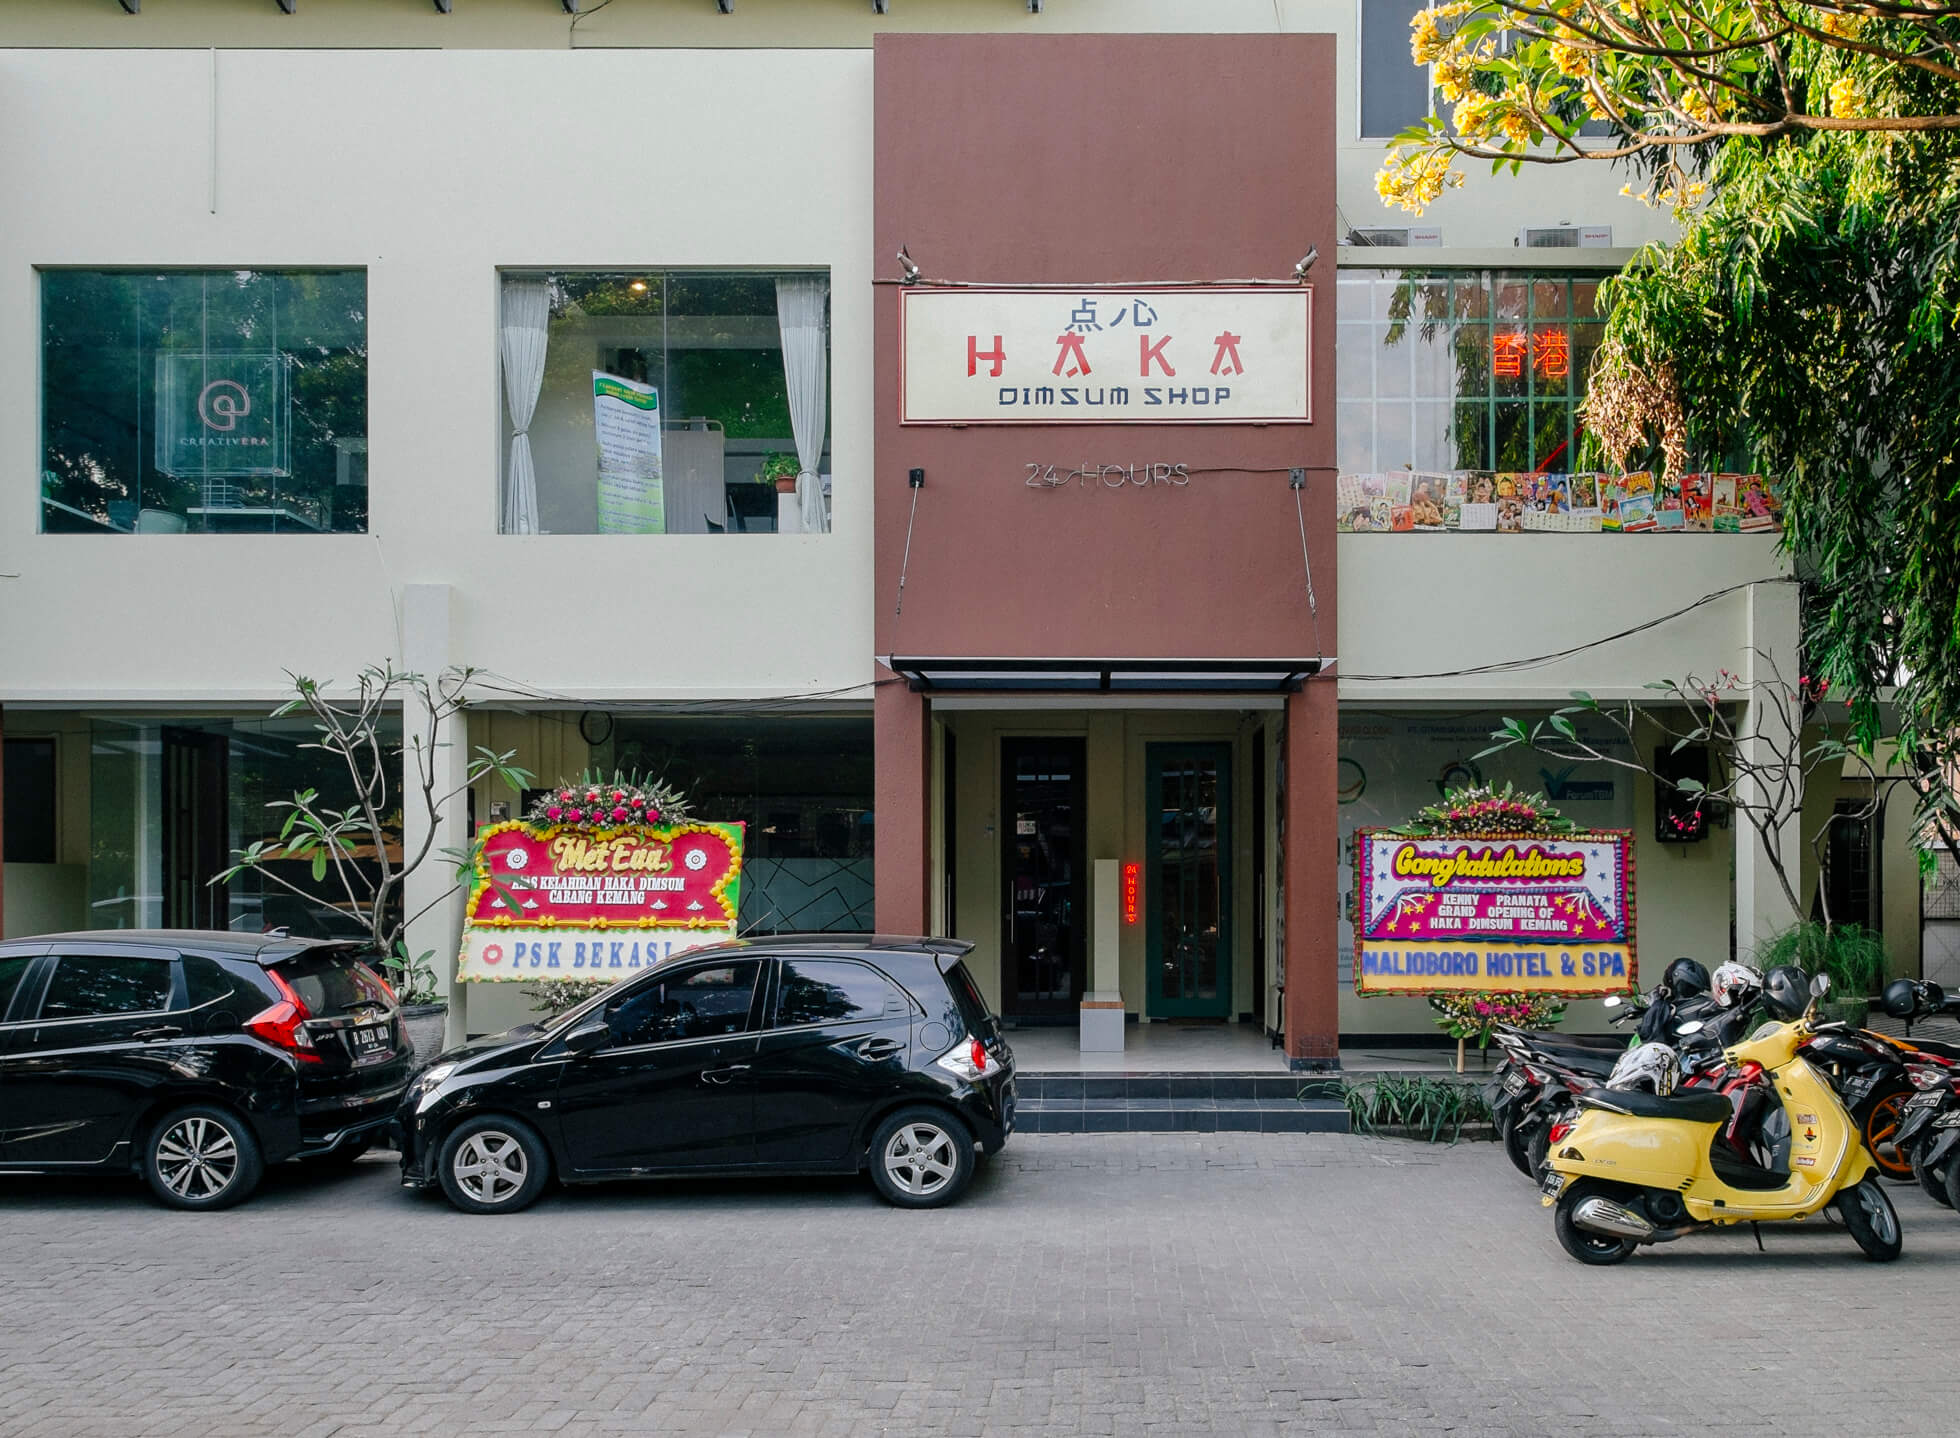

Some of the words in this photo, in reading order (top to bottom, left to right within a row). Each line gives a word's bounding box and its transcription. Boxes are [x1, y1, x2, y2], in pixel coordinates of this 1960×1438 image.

[967, 331, 1245, 378] HAKA
[1493, 329, 1569, 377] 香港
[998, 386, 1129, 406] DIMSUM
[1143, 387, 1231, 406] SHOP
[180, 437, 269, 447] CREATIVERA
[1025, 463, 1060, 487] 24
[1081, 463, 1189, 487] HOURS
[553, 836, 610, 871] Met
[1126, 865, 1137, 874] 24
[1394, 846, 1584, 887] Congratulations
[540, 876, 600, 890] KELAHIRAN
[604, 877, 635, 890] HAKA
[639, 877, 685, 891] DIMSUM
[549, 890, 593, 904] CABANG
[597, 891, 645, 905] KEMANG
[1127, 877, 1137, 922] HOURS
[1443, 894, 1480, 906] KENNY
[1496, 895, 1549, 907] PRANATA
[1438, 905, 1476, 917] GRAND
[1488, 907, 1535, 919] OPENING
[1539, 907, 1555, 919] OF
[1430, 917, 1462, 929] HAKA
[1469, 918, 1513, 930] DIMSUM
[1520, 919, 1569, 931] KEMANG
[512, 941, 562, 968] PSK
[1363, 951, 1479, 977] MALIOBORO
[1486, 952, 1552, 977] HOTEL
[1560, 952, 1577, 977] &
[1582, 952, 1626, 977] SPA
